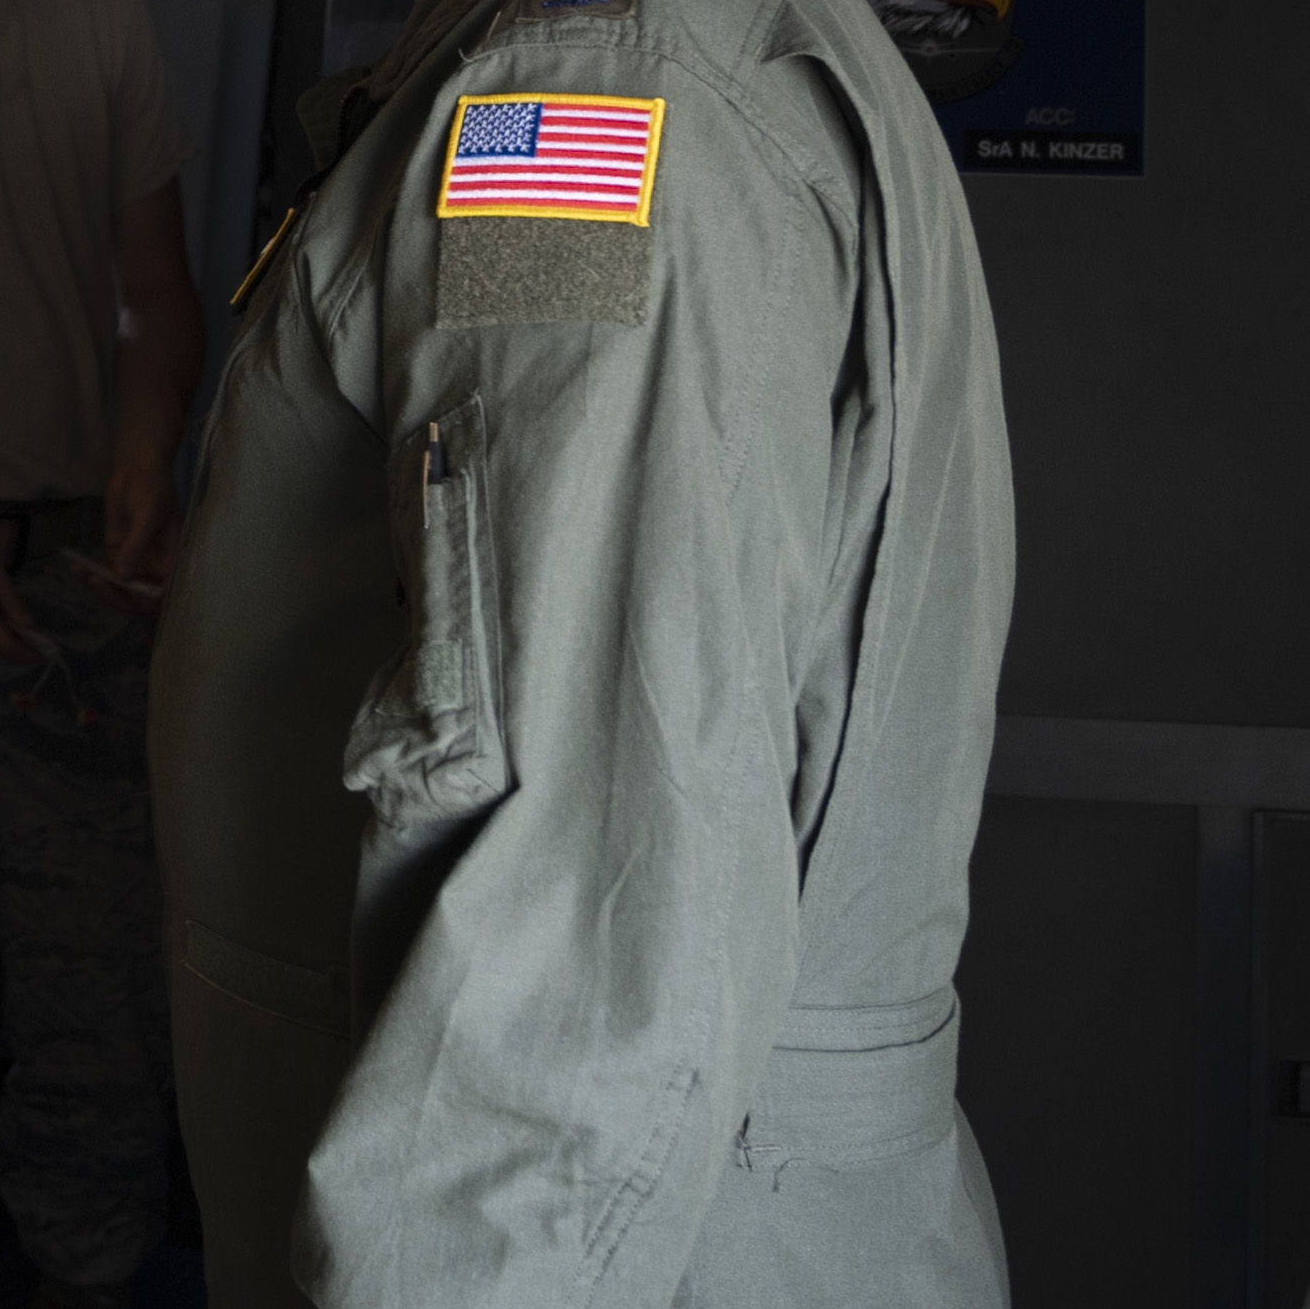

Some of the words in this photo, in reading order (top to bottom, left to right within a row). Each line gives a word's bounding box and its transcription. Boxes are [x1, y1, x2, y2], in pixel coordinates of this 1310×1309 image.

[1024, 106, 1076, 127] ACC:
[977, 139, 1013, 159] SrA
[1020, 140, 1042, 159] N.
[1048, 140, 1125, 161] KINZER
